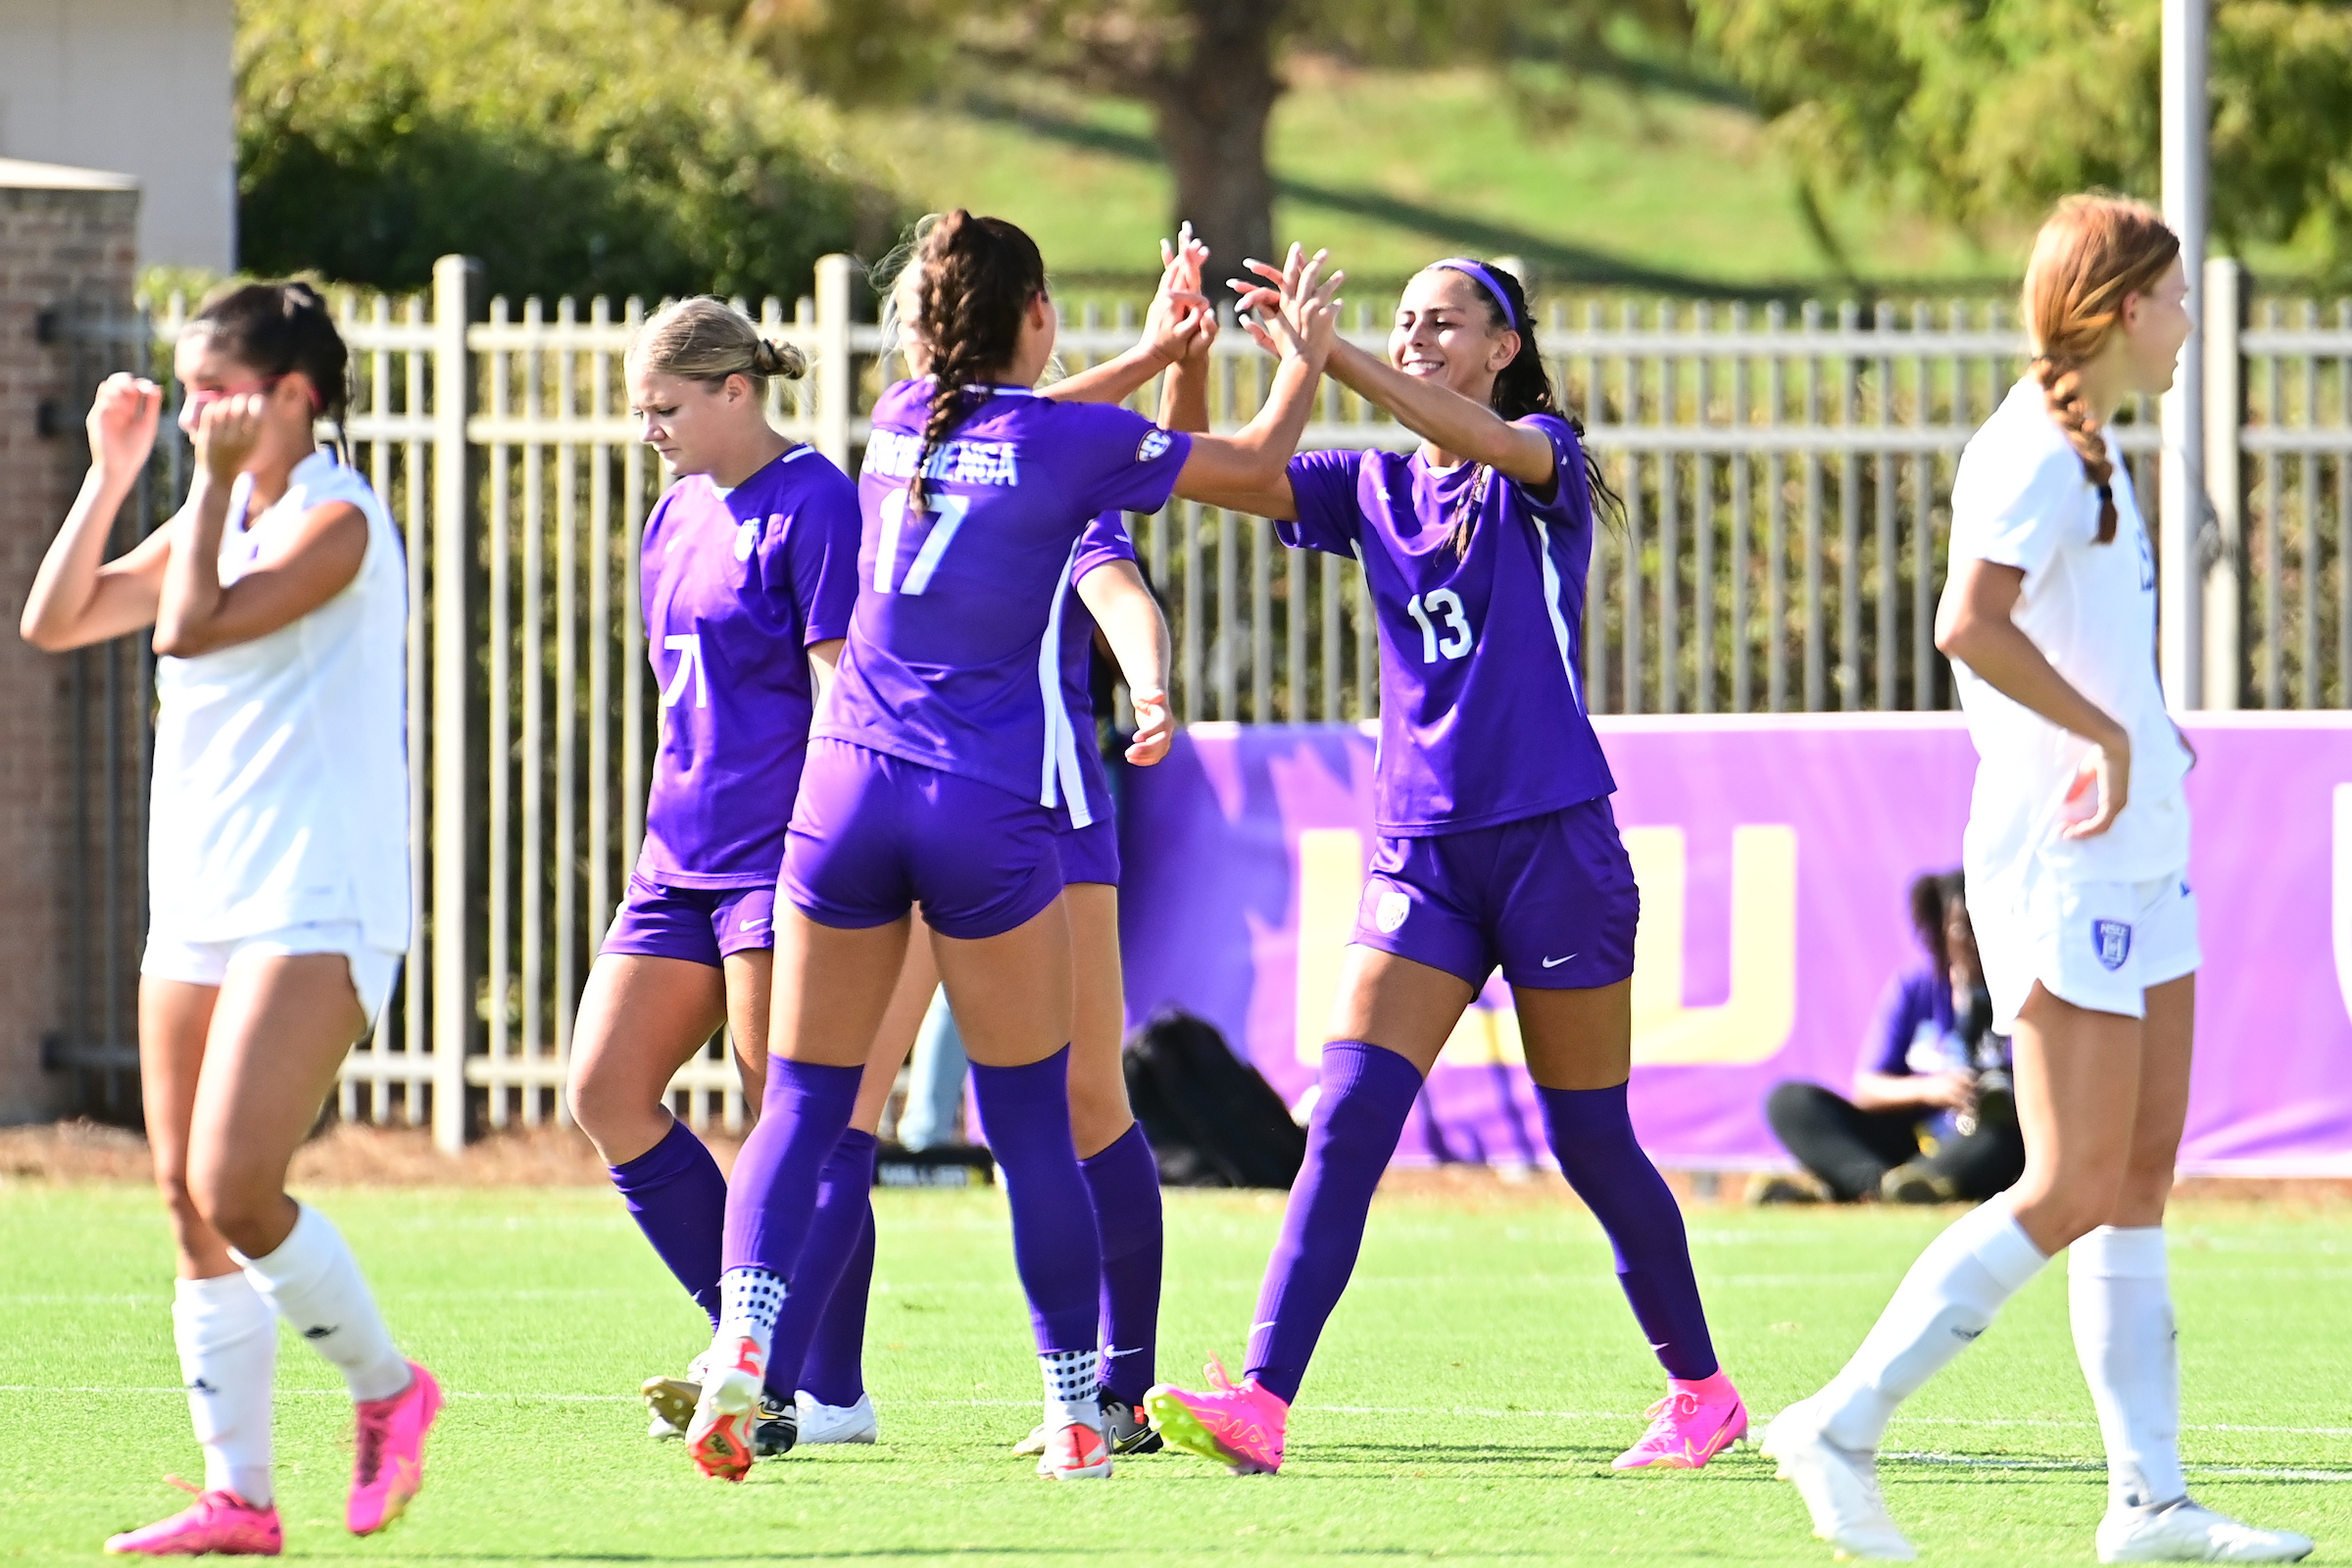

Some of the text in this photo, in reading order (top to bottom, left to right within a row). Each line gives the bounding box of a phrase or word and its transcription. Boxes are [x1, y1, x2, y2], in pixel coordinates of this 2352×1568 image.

[873, 488, 970, 596] 17
[1407, 587, 1473, 664] 13
[1296, 824, 1796, 1066] LU
